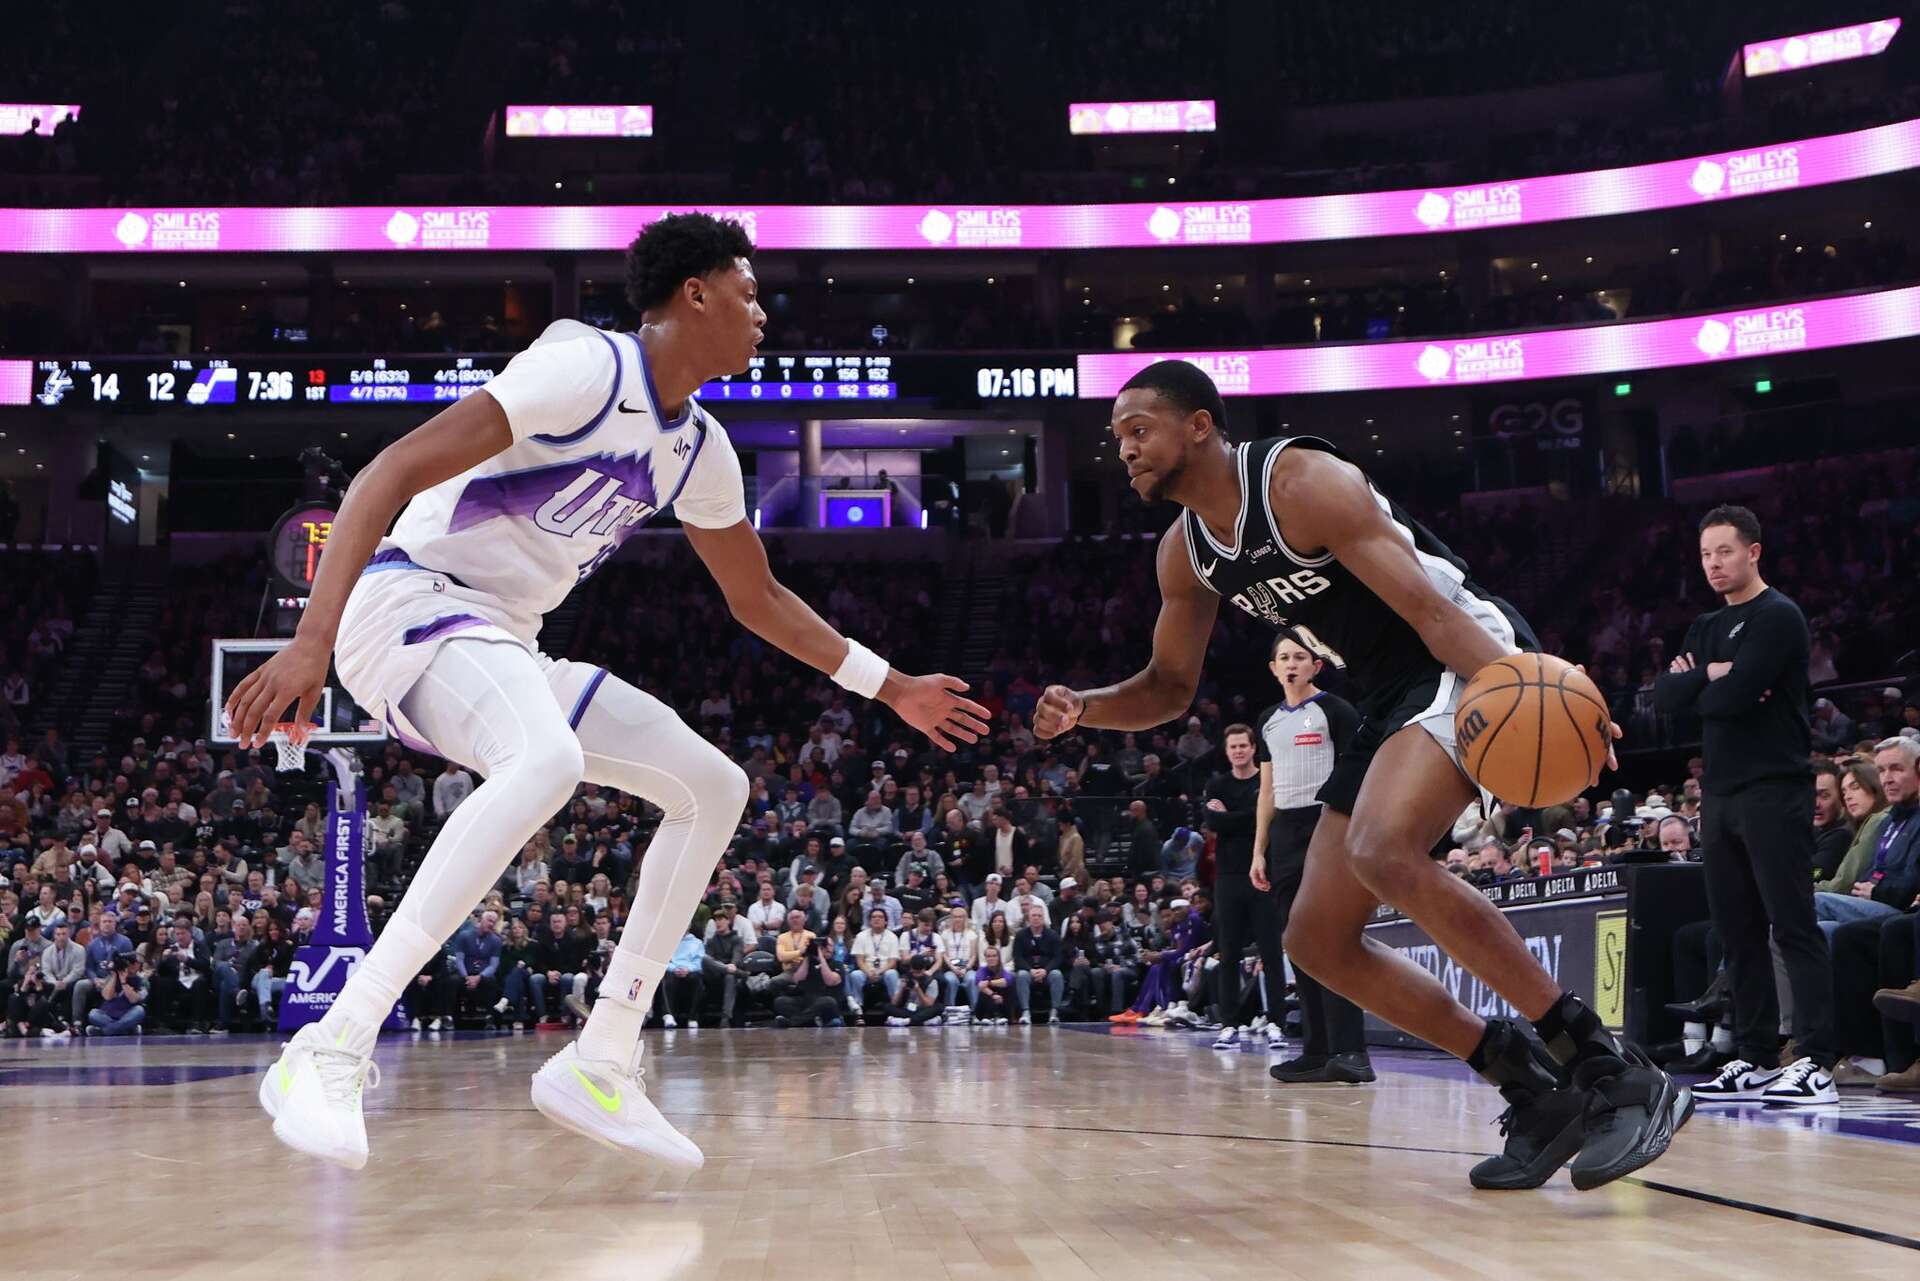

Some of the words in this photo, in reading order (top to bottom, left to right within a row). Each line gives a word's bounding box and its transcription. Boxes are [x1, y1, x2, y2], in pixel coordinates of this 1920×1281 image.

[1728, 147, 1798, 175] SMILEYS
[1452, 185, 1521, 208] SMILEYS
[153, 211, 220, 229] SMILEYS
[422, 211, 489, 228] SMILEYS
[957, 209, 1021, 227] SMILEYS
[1184, 204, 1251, 224] SMILEYS
[1733, 308, 1804, 334] SMILEYS
[1454, 339, 1522, 361] SMILEYS
[308, 370, 325, 384] 13
[751, 368, 762, 381] 0
[782, 368, 790, 381] 1
[813, 368, 824, 381] 0
[837, 368, 859, 381] 156
[867, 368, 889, 381] 152
[977, 368, 1036, 397] 07:16
[1040, 368, 1075, 397] PM
[91, 373, 120, 400] 14
[147, 372, 176, 400] 12
[248, 371, 294, 400] 7:36
[305, 387, 326, 400] 1ST
[350, 386, 373, 399] 4/7
[434, 386, 457, 399] 2/4
[751, 384, 762, 398] 0
[781, 384, 792, 398] 0
[813, 384, 824, 398] 0
[837, 384, 859, 398] 152
[867, 384, 890, 398] 156
[302, 522, 332, 543] 7:3
[1230, 569, 1332, 625] PURS
[334, 816, 351, 861] FIRST
[1551, 877, 1575, 894] DELTA
[1591, 871, 1618, 889] DELTA
[1514, 882, 1537, 898] DELTA
[333, 863, 348, 936] AMERICA
[287, 992, 337, 1004] AMERIC
